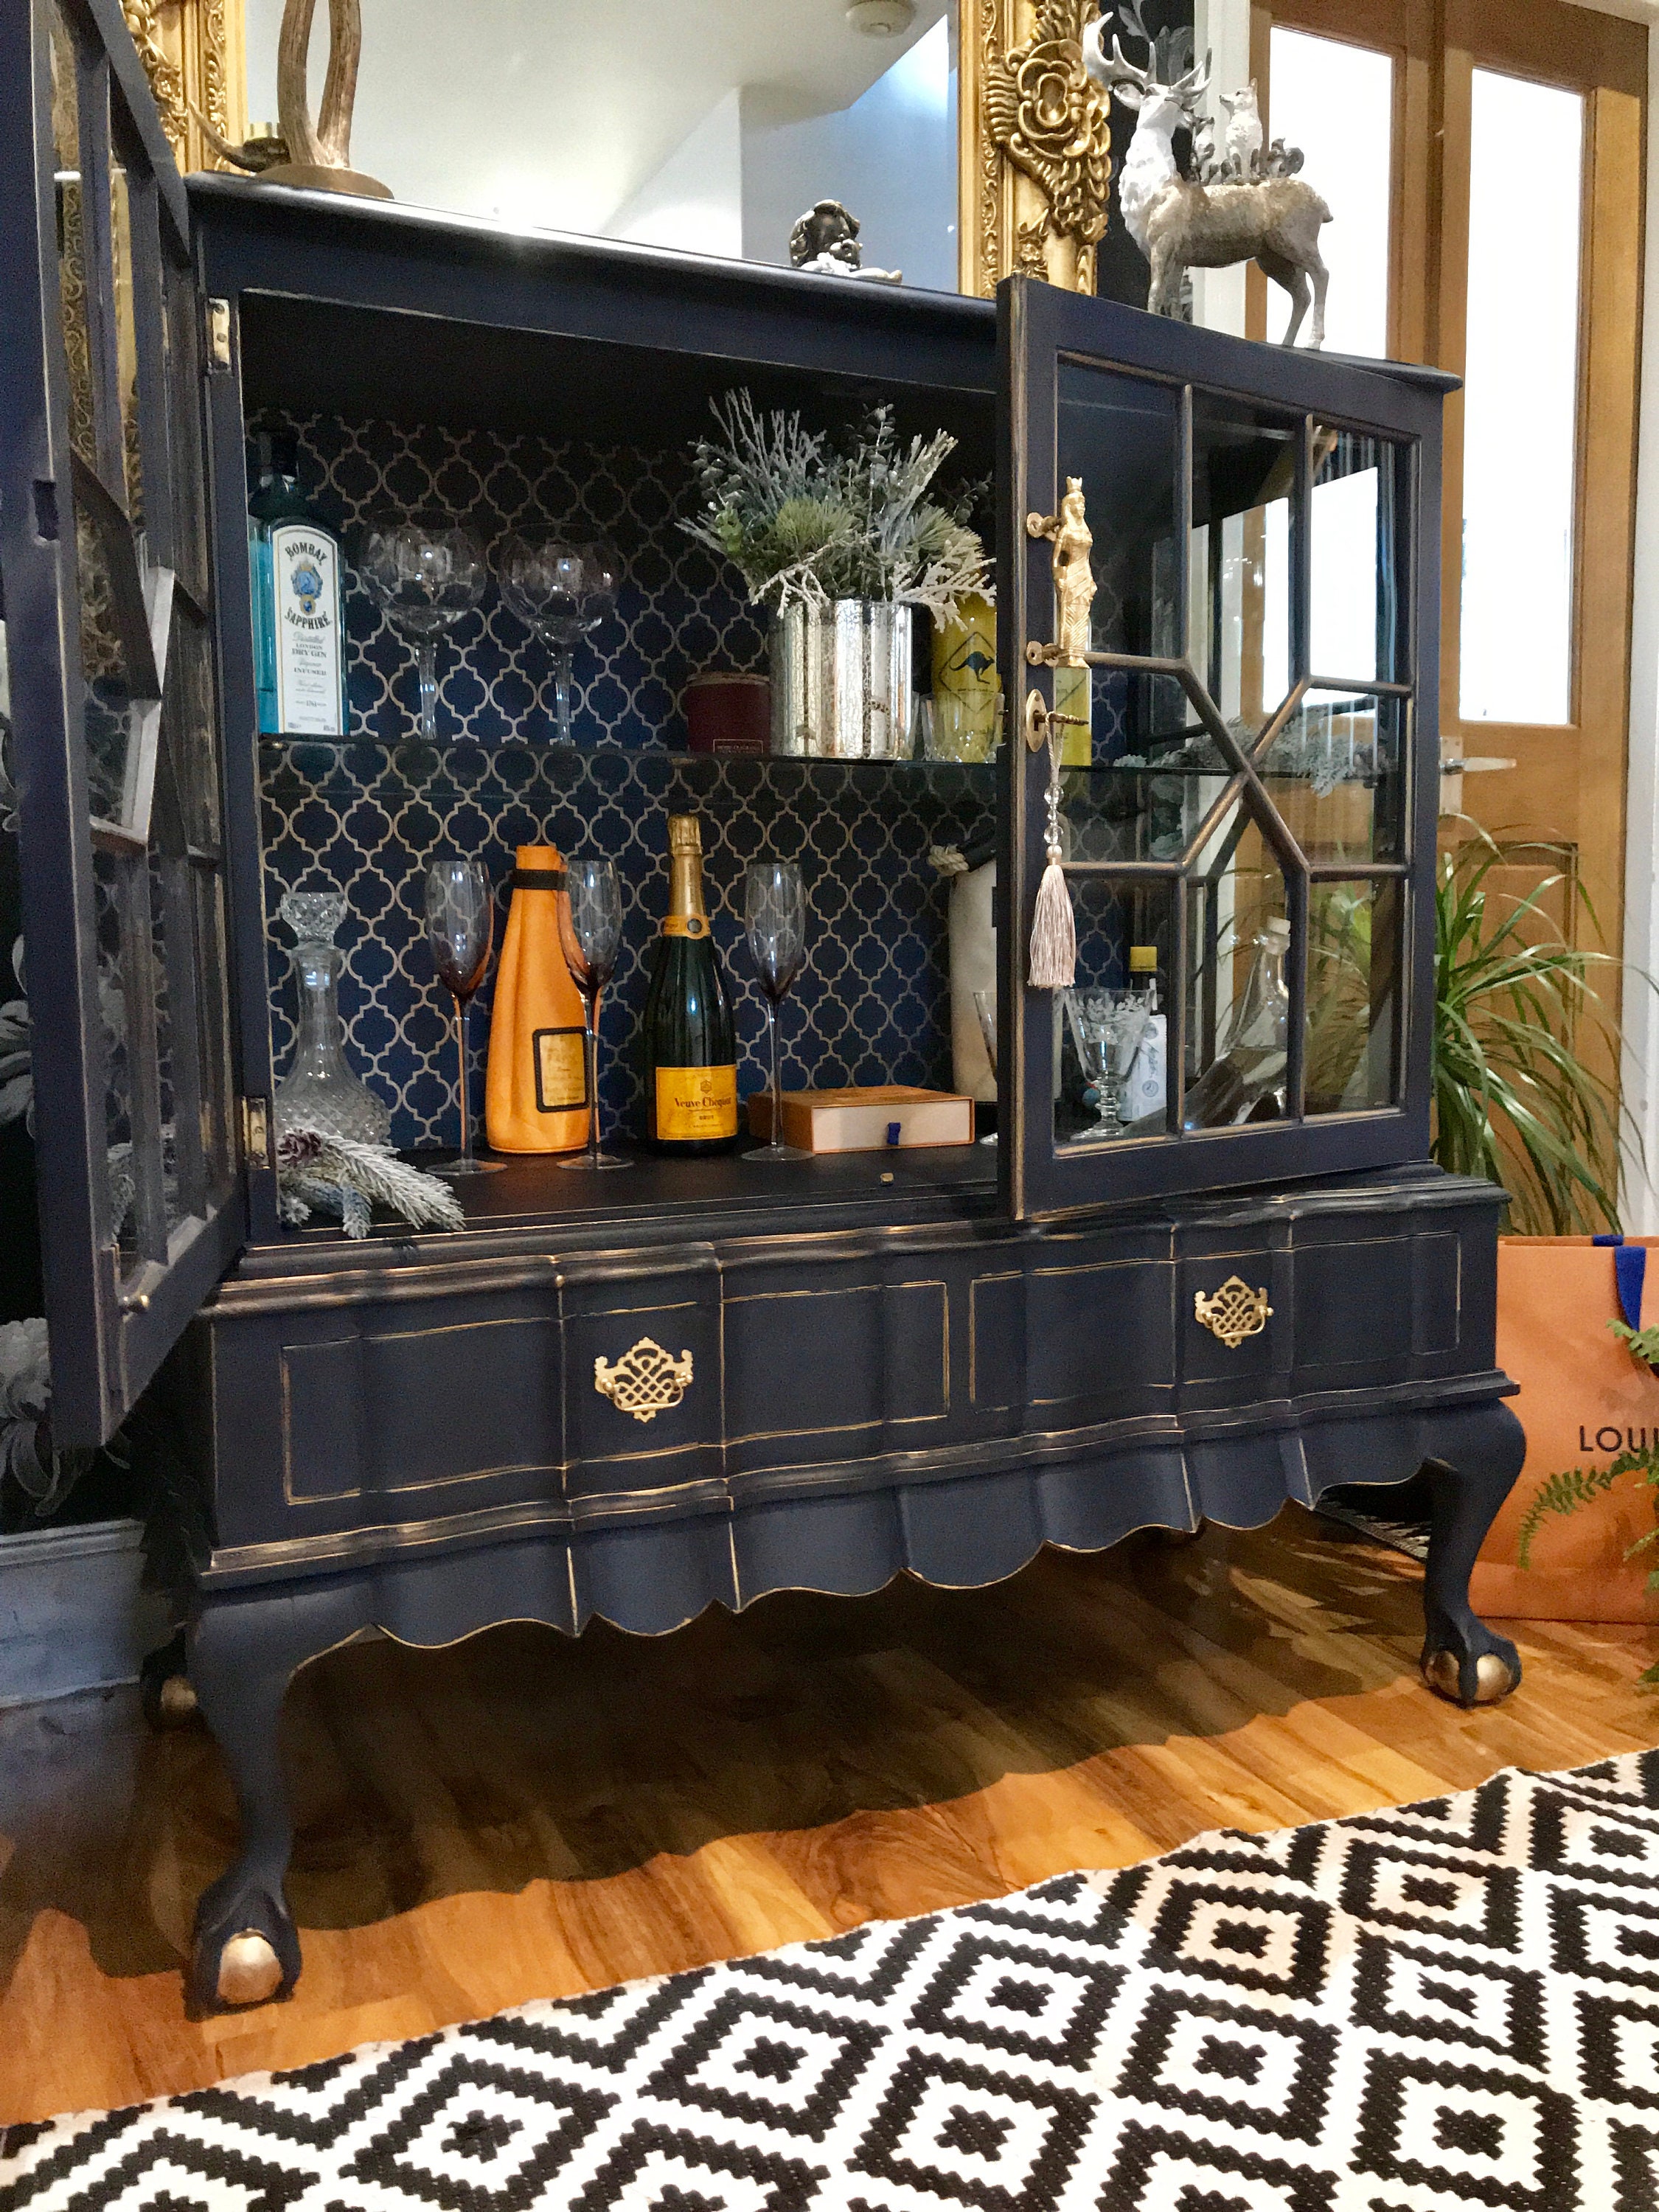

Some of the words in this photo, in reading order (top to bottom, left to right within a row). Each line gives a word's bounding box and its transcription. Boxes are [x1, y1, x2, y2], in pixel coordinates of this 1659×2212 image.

[285, 542, 327, 566] BOMBAY
[285, 606, 330, 630] SAPPHIRE
[675, 1097, 700, 1108] Veuve
